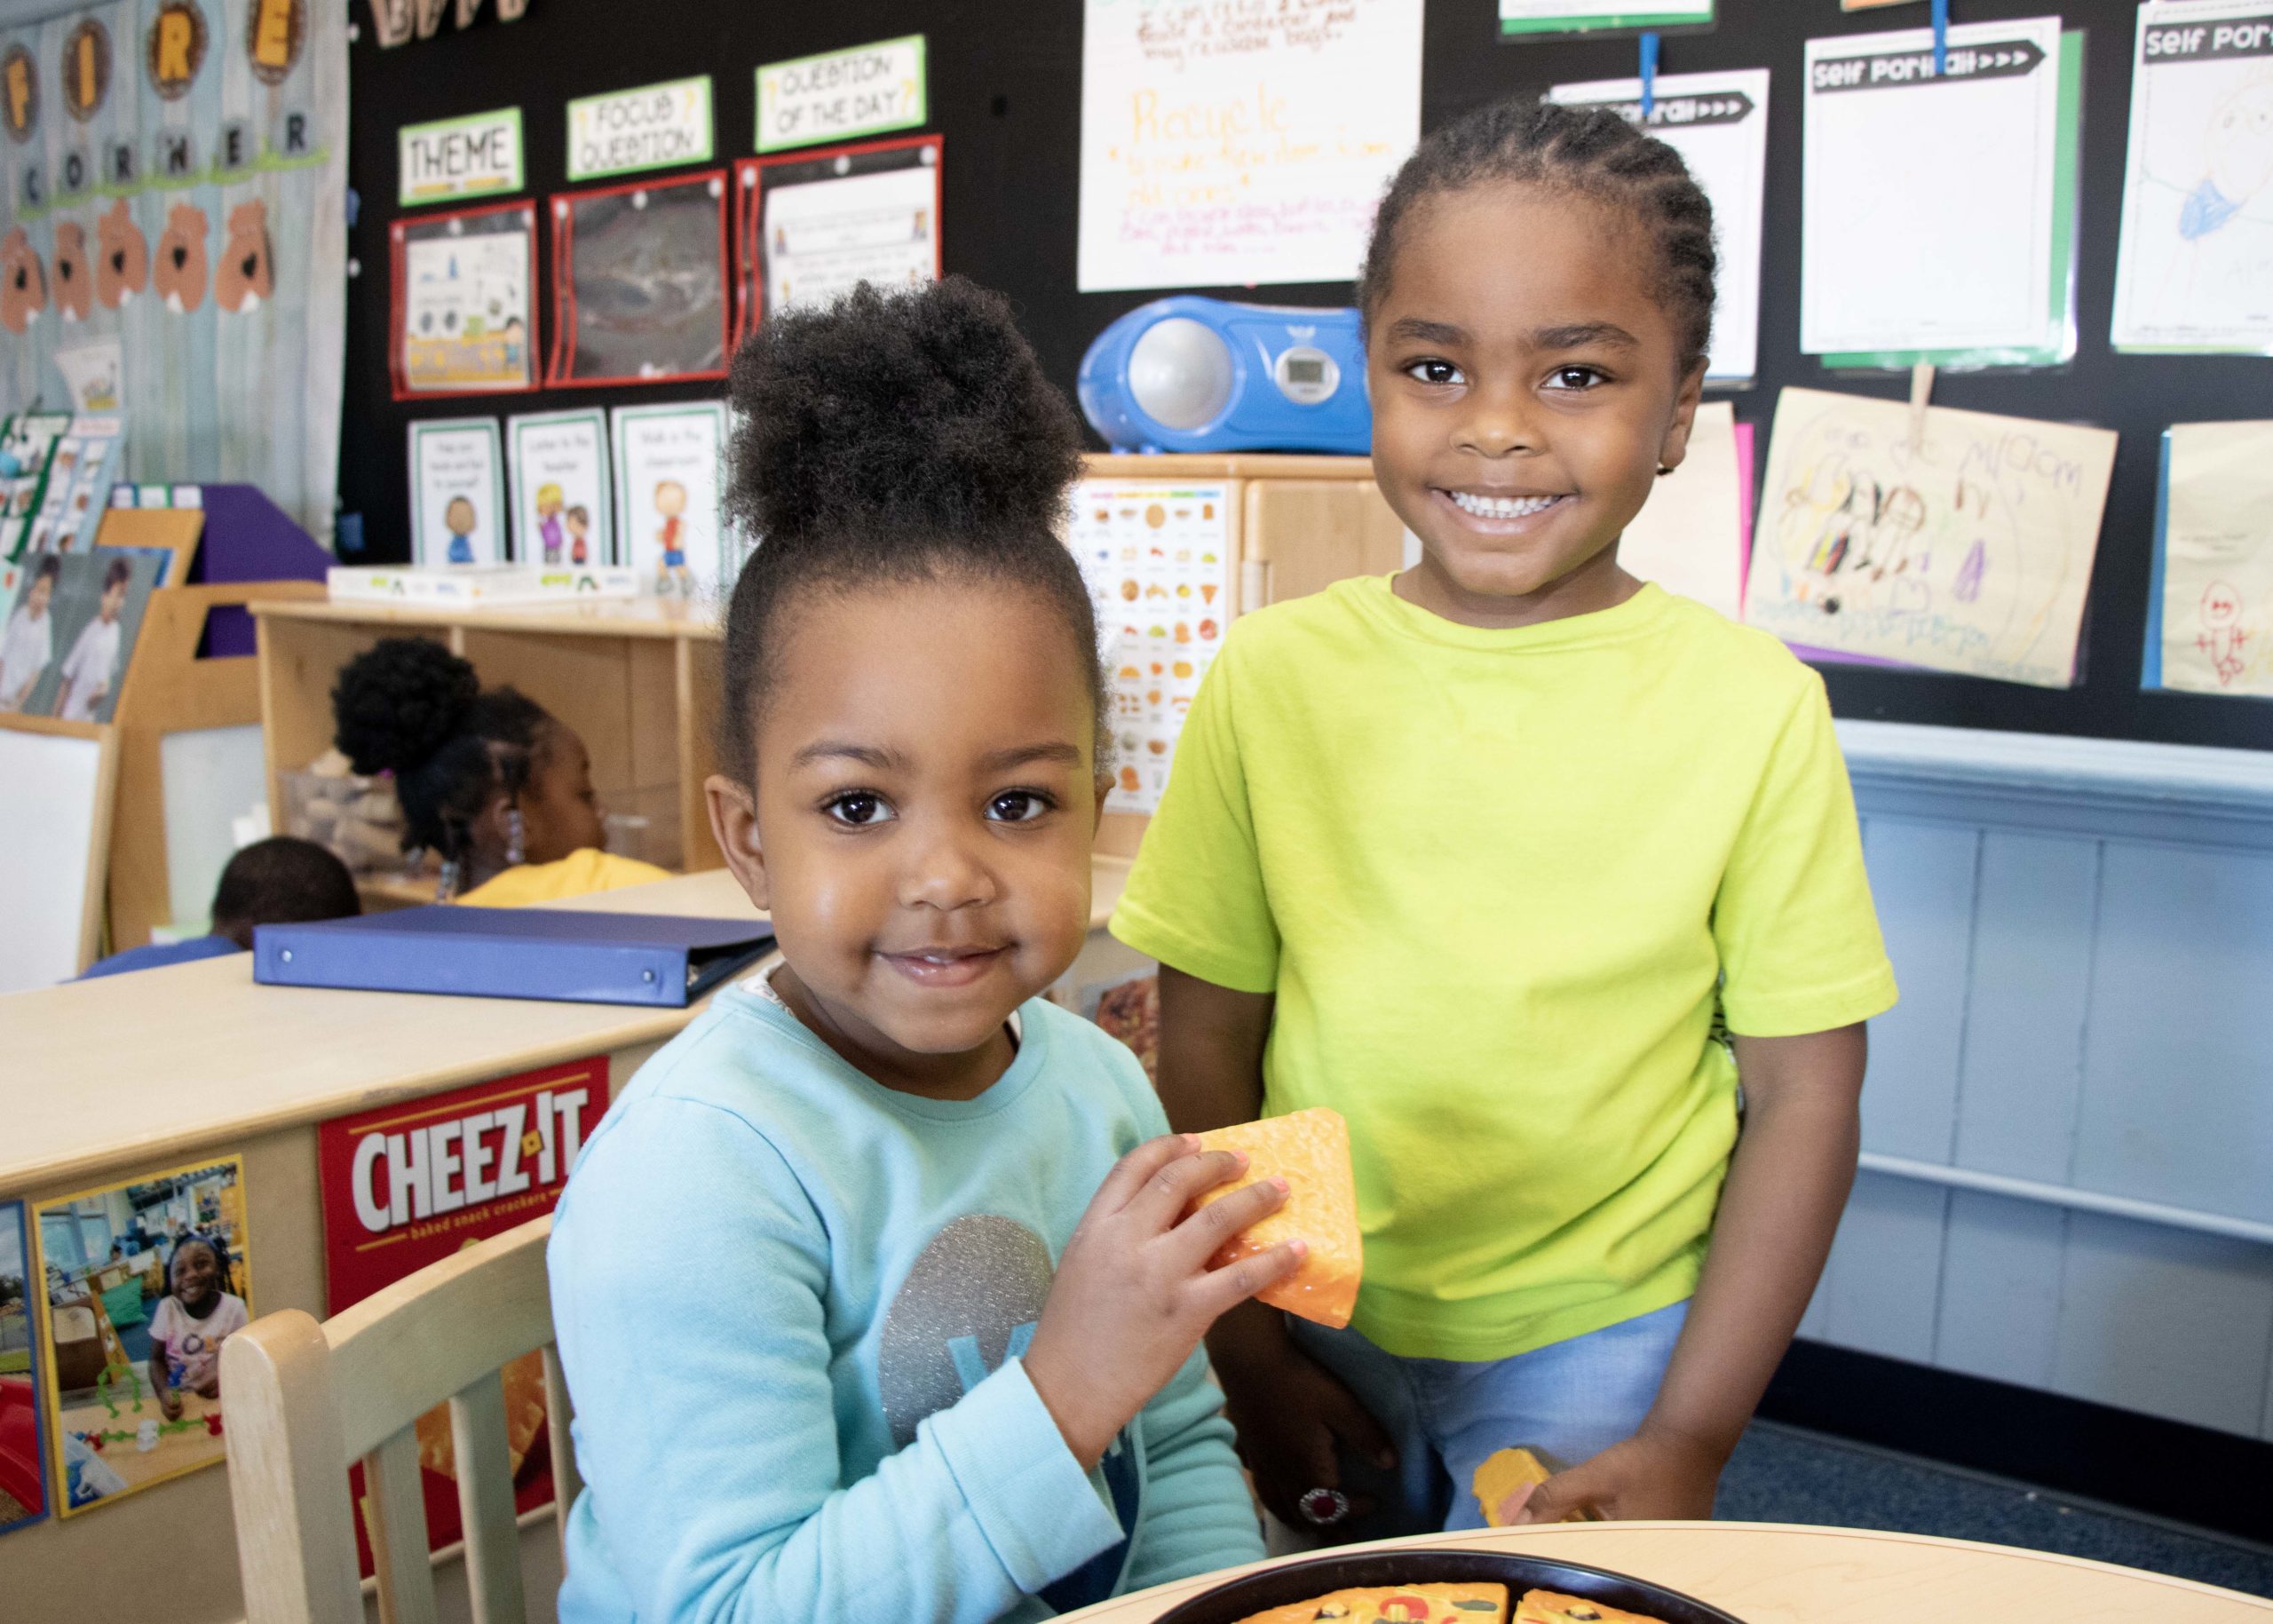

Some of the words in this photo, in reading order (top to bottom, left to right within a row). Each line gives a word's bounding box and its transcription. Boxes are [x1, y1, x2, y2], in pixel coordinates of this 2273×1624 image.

[780, 53, 894, 97] QUESTION
[596, 91, 674, 132] FOCUS
[776, 104, 805, 134] OF
[812, 99, 846, 126] THE
[853, 90, 899, 121] DAY
[1129, 80, 1290, 157] Recycle
[26, 113, 307, 204] CORNER
[409, 126, 511, 178] THEME
[581, 127, 696, 172] QUESTION
[410, 1217, 451, 1240] baked
[454, 1207, 491, 1229] snack
[494, 1192, 547, 1216] crackers
